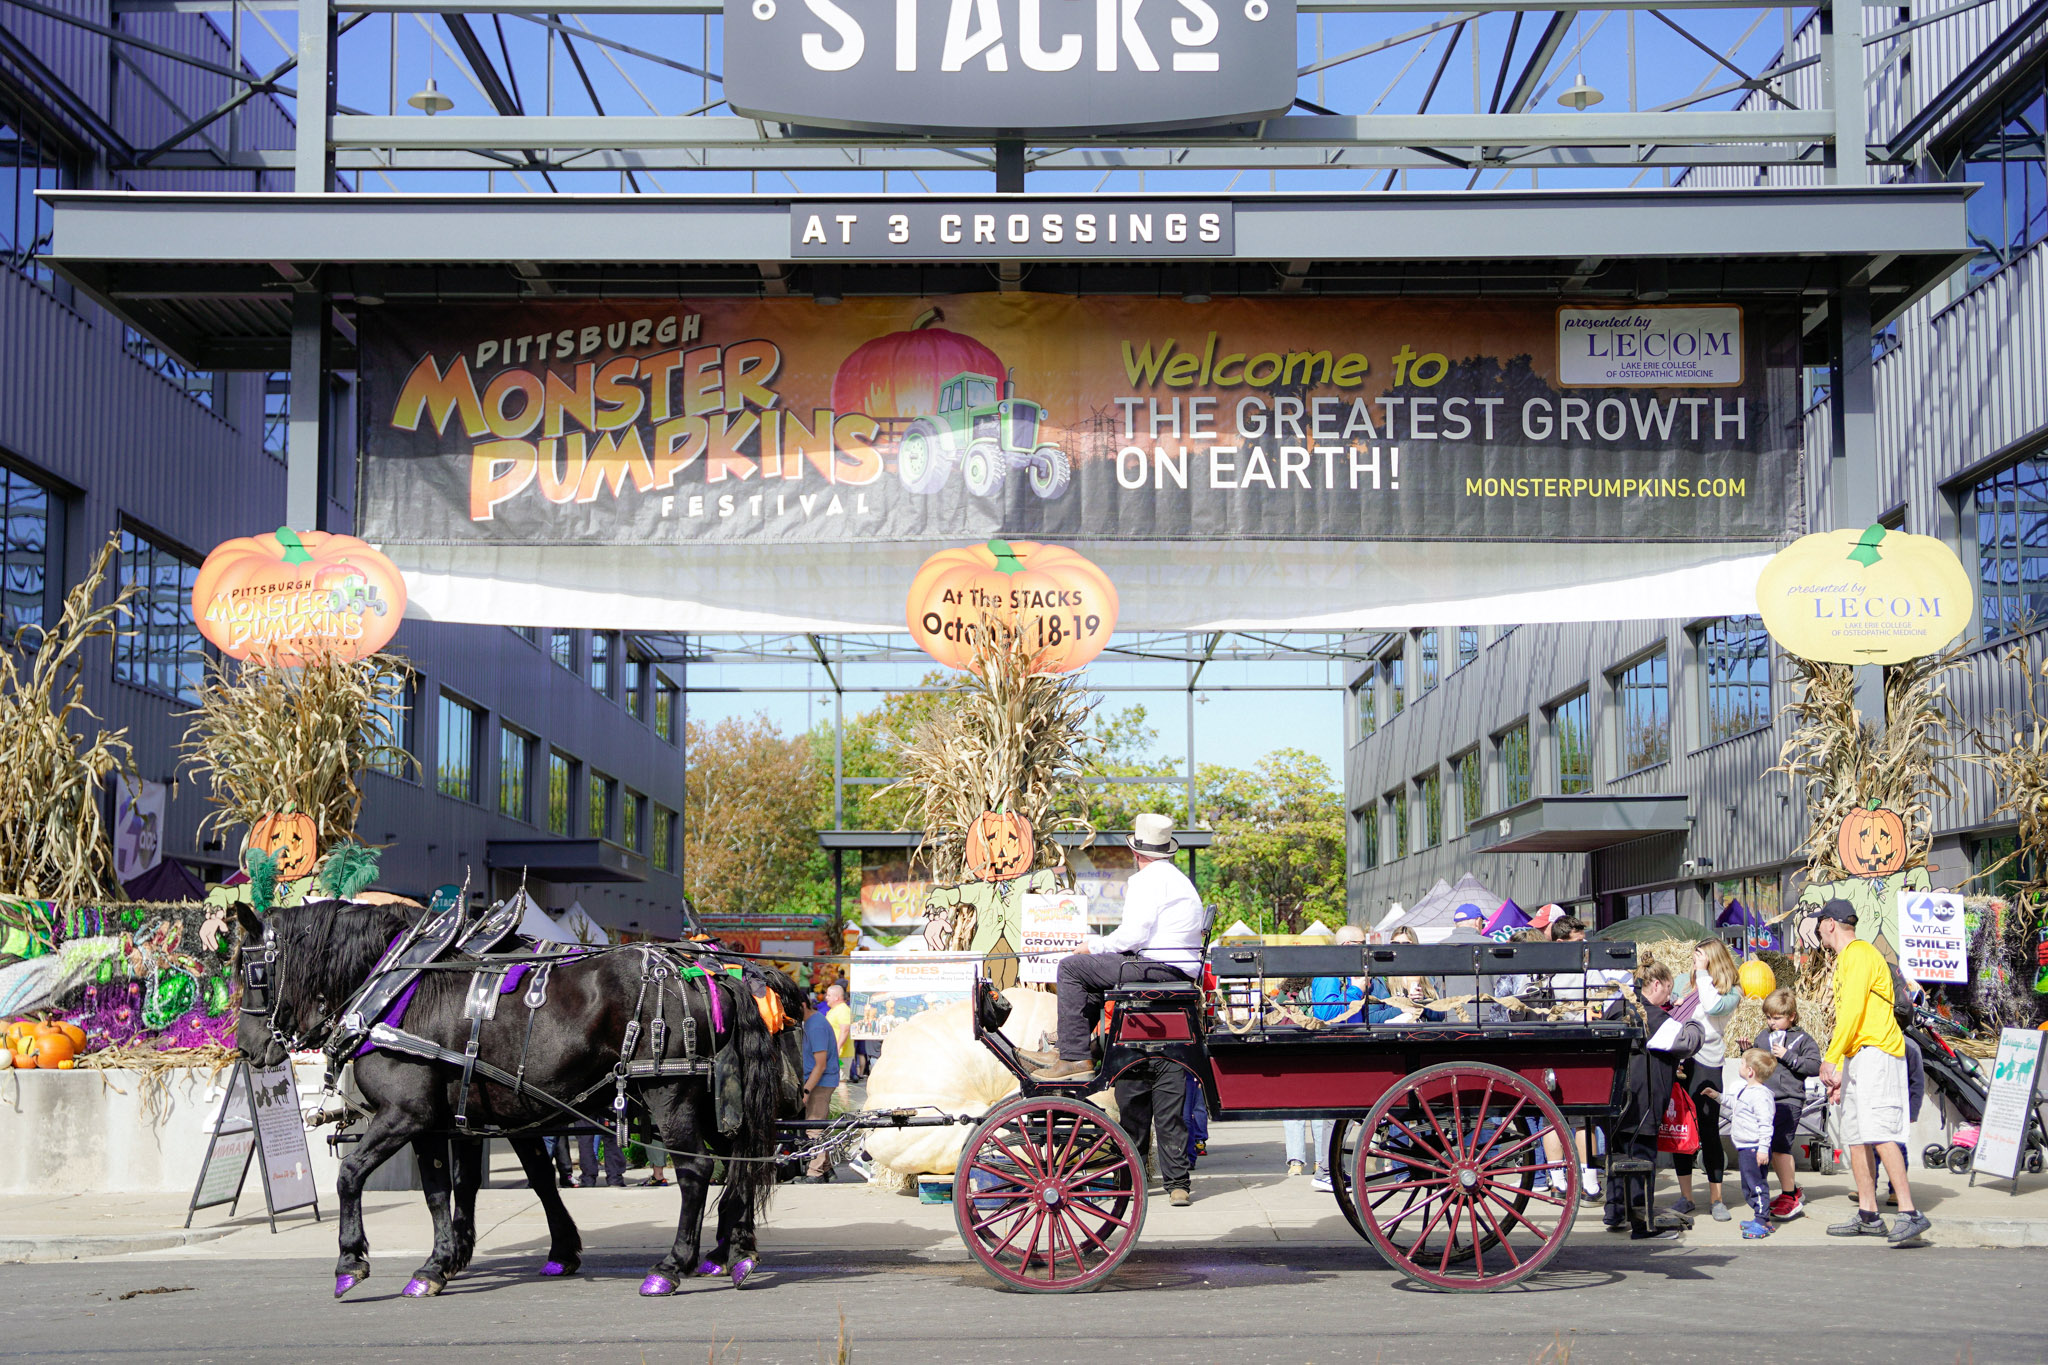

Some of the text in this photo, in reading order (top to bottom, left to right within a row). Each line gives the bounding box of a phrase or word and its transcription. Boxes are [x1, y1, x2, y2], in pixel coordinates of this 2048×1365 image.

[802, 213, 1221, 244] AT 3 CROSSINGS
[1565, 315, 1652, 331] presented by
[475, 313, 701, 369] PITTSBURGH
[1121, 331, 1449, 389] Welcome to
[1621, 362, 1642, 370] LAKE
[1606, 370, 1714, 378] OF OSTEOPATHIC MEDICINE
[392, 338, 780, 439] MONSTER
[1114, 396, 1746, 439] THE GREATEST GROWTH
[470, 408, 884, 521] PUMPKINS
[1115, 446, 1400, 490] ON EARTH!
[1466, 477, 1746, 499] MONSTERPUMPKINS.COM
[661, 494, 871, 518] FESTIVAL
[231, 579, 312, 599] PITTSBURGH
[1787, 582, 1867, 596] presented by
[205, 589, 332, 623] MONSTER
[942, 588, 1083, 609] At The STACKS
[229, 610, 364, 650] PUMPKINS
[1037, 614, 1100, 648] 18-19
[1933, 905, 1956, 916] abc
[1022, 931, 1085, 939] GREATEST
[1913, 925, 1951, 935] WTAE
[1025, 938, 1083, 947] GROWTH
[1905, 938, 1960, 950] SMILE!
[1917, 949, 1949, 959] IT'S
[895, 966, 939, 975] RIDES
[1908, 958, 1959, 969] SHOW
[1913, 968, 1955, 979] TIME
[1659, 1124, 1688, 1133] REACH
